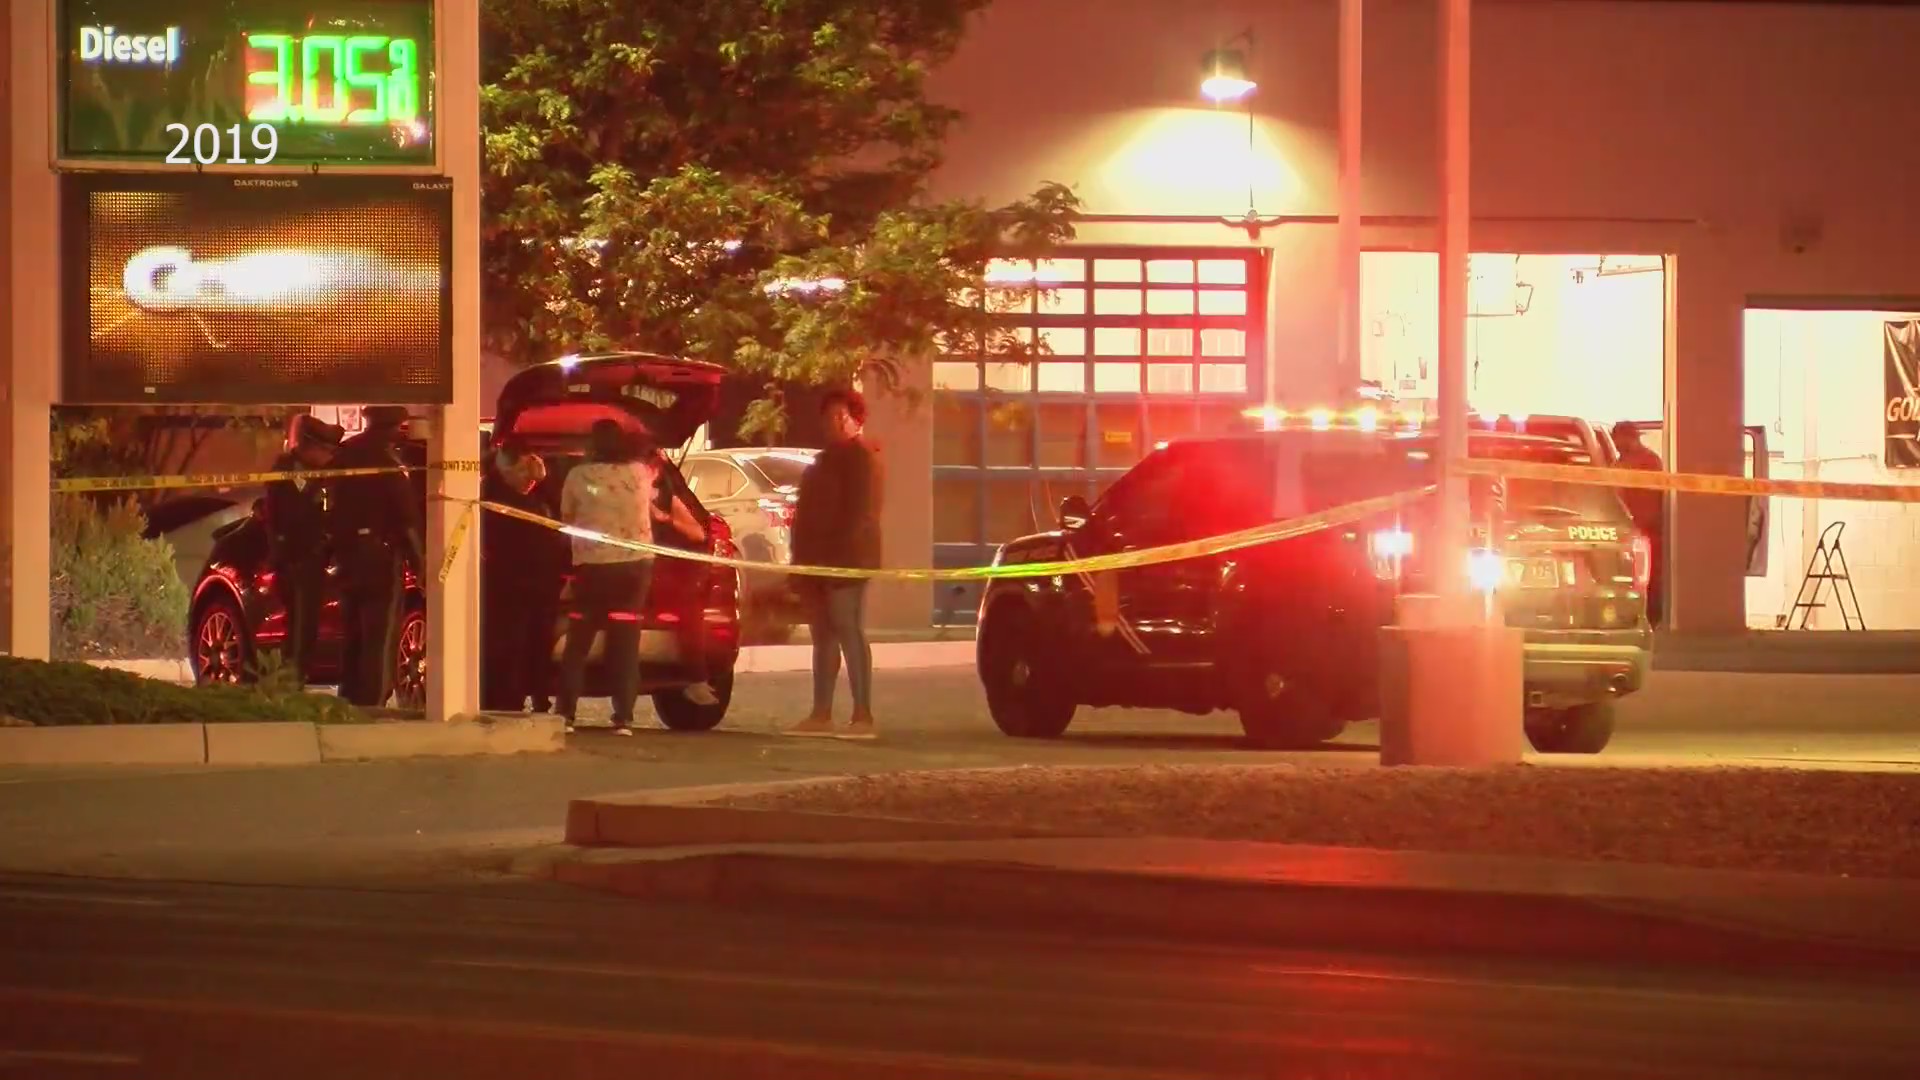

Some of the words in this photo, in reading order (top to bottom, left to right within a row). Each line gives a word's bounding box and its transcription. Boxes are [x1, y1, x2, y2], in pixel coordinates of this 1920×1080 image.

[79, 26, 178, 62] Diesel
[233, 179, 299, 188] DAKTRONICS
[412, 182, 450, 190] GALAXY
[1567, 525, 1619, 541] POLICE
